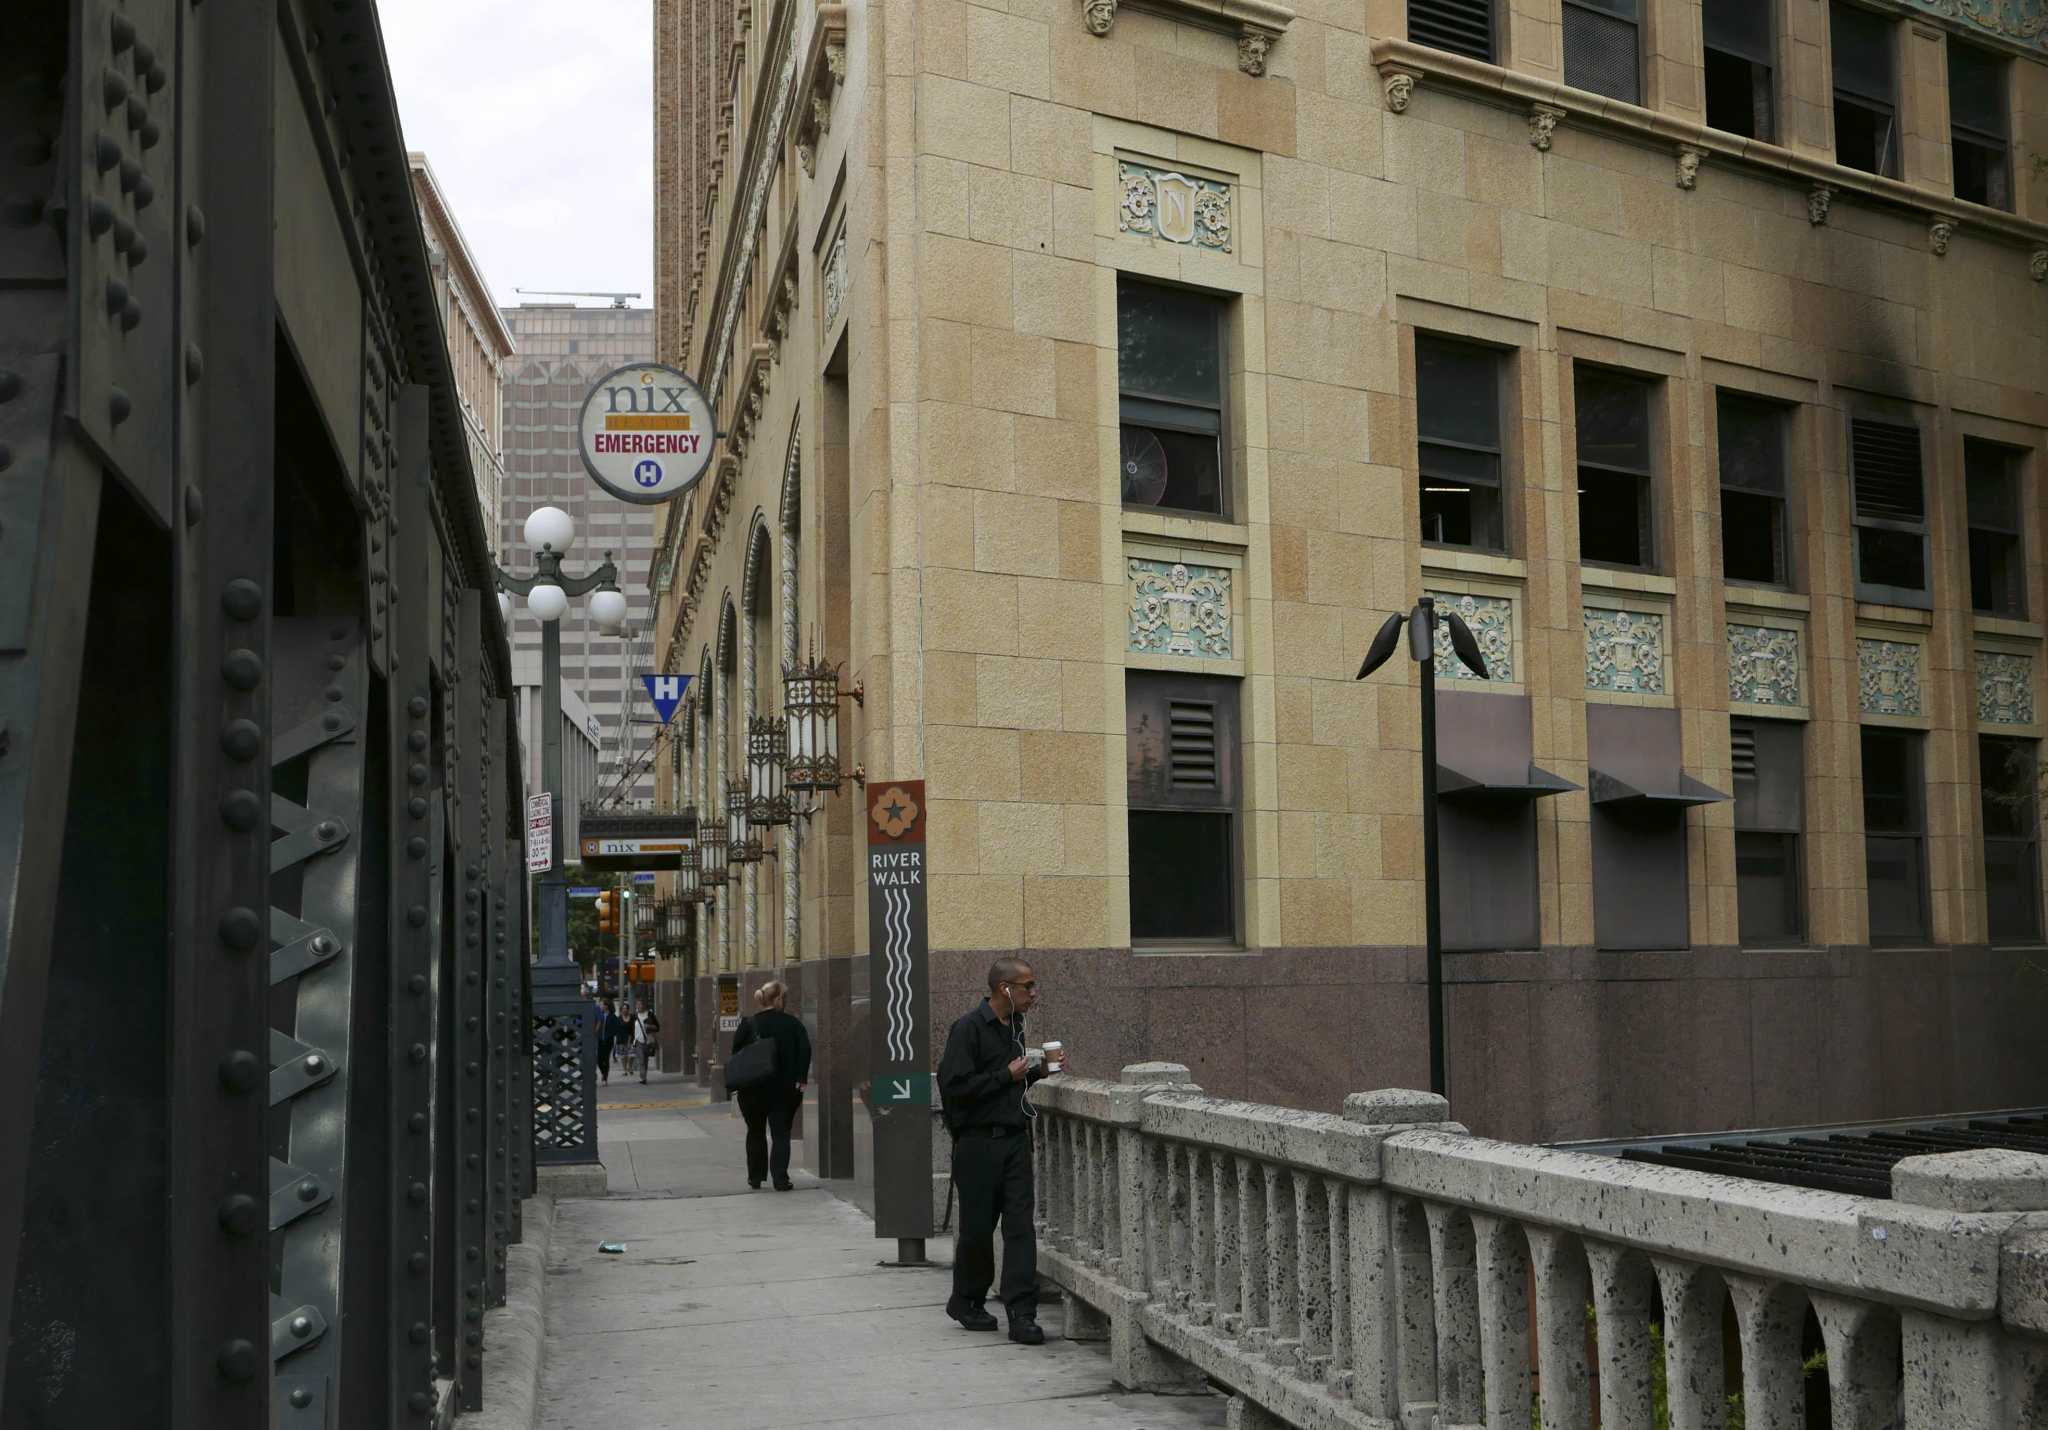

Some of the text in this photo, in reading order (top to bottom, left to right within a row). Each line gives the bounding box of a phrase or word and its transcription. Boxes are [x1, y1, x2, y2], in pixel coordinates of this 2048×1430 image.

[604, 373, 690, 413] nix
[595, 434, 700, 454] EMERGENCY
[639, 464, 657, 483] H
[655, 676, 679, 700] H
[607, 840, 634, 853] nix
[872, 852, 920, 869] RIVER
[873, 870, 920, 886] WALK
